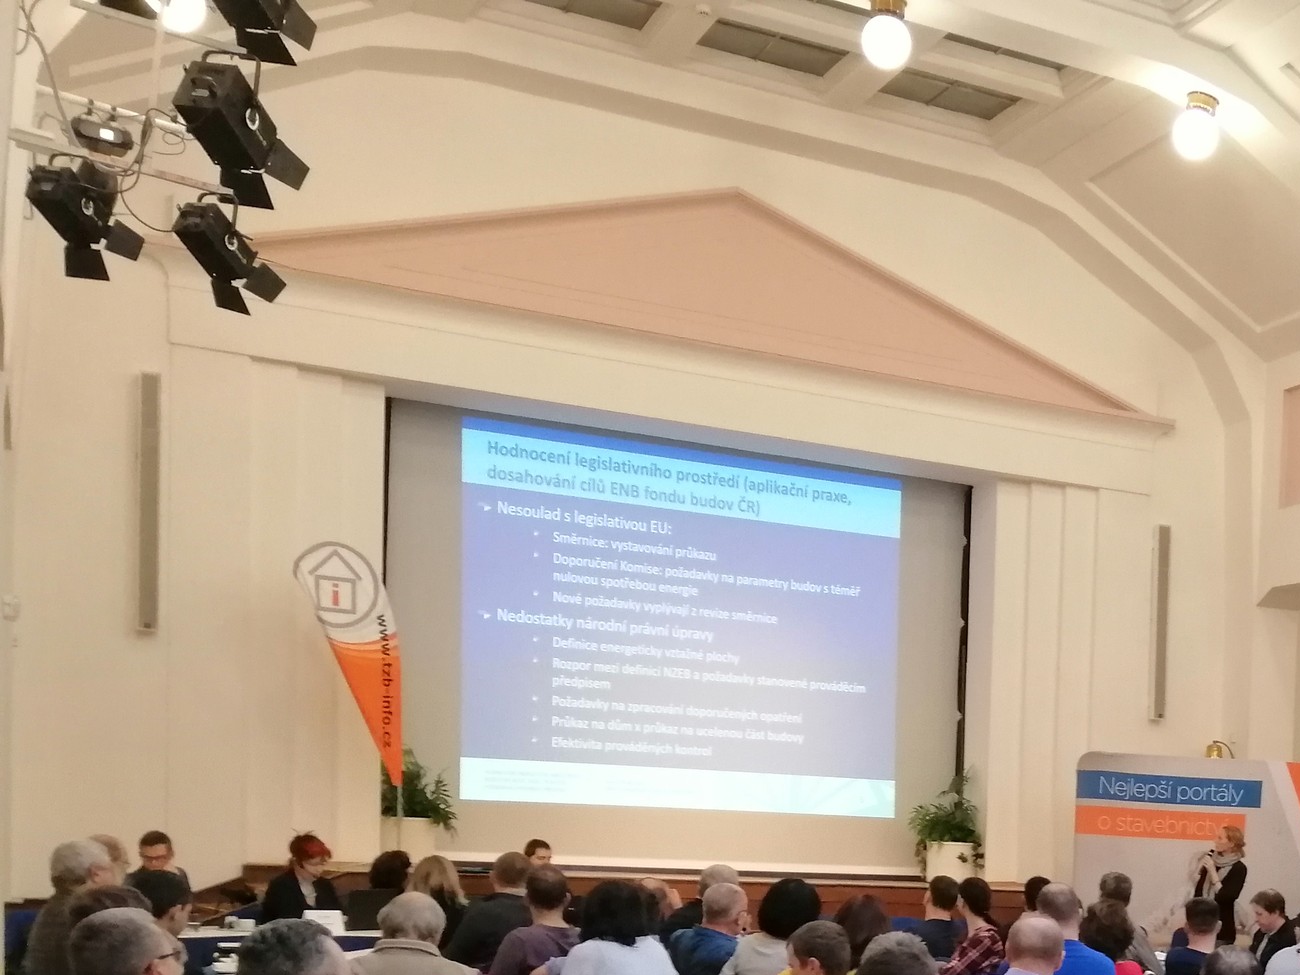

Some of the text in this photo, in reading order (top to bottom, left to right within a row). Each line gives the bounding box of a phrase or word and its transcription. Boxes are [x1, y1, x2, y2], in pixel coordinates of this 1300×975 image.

[487, 440, 852, 506] Hodnocení legislativního prostředí (aplikační praxe,
[487, 464, 761, 518] dosahování cílů ENB fondu budov ČR)
[497, 500, 673, 535] Nesoulad s legislativou EU:
[552, 531, 717, 562] Směrnice: vystavování průkazu
[552, 552, 619, 571] Doporučení
[620, 561, 663, 576] Komise:
[665, 566, 719, 584] požadavky
[721, 573, 734, 584] na
[736, 575, 789, 592] parametry
[790, 579, 822, 594] budov
[830, 584, 861, 598] téměř
[552, 571, 699, 598] nulovou spotřebou energie
[552, 591, 779, 625] Nové požadavky vyplývají z revize směrnice
[497, 608, 714, 643] Nedostatky národní právní úpravy
[552, 636, 599, 651] Definice
[600, 642, 663, 659] energeticky
[706, 650, 740, 665] plochy
[376, 613, 394, 749] www.tzb-info.cz
[551, 674, 611, 690] předpisem
[552, 657, 592, 674] Rozpor
[593, 662, 619, 674] mezi
[692, 671, 700, 681] a
[702, 670, 755, 686] požadavky
[756, 675, 808, 690] stanovené
[551, 695, 610, 712] Požadavky
[611, 701, 626, 711] na
[627, 703, 685, 716] zpracování
[551, 715, 589, 729] Průkaz
[591, 720, 605, 730] na
[680, 726, 695, 736] na
[1098, 775, 1244, 806] Nejlepší portály
[1097, 815, 1112, 831] o
